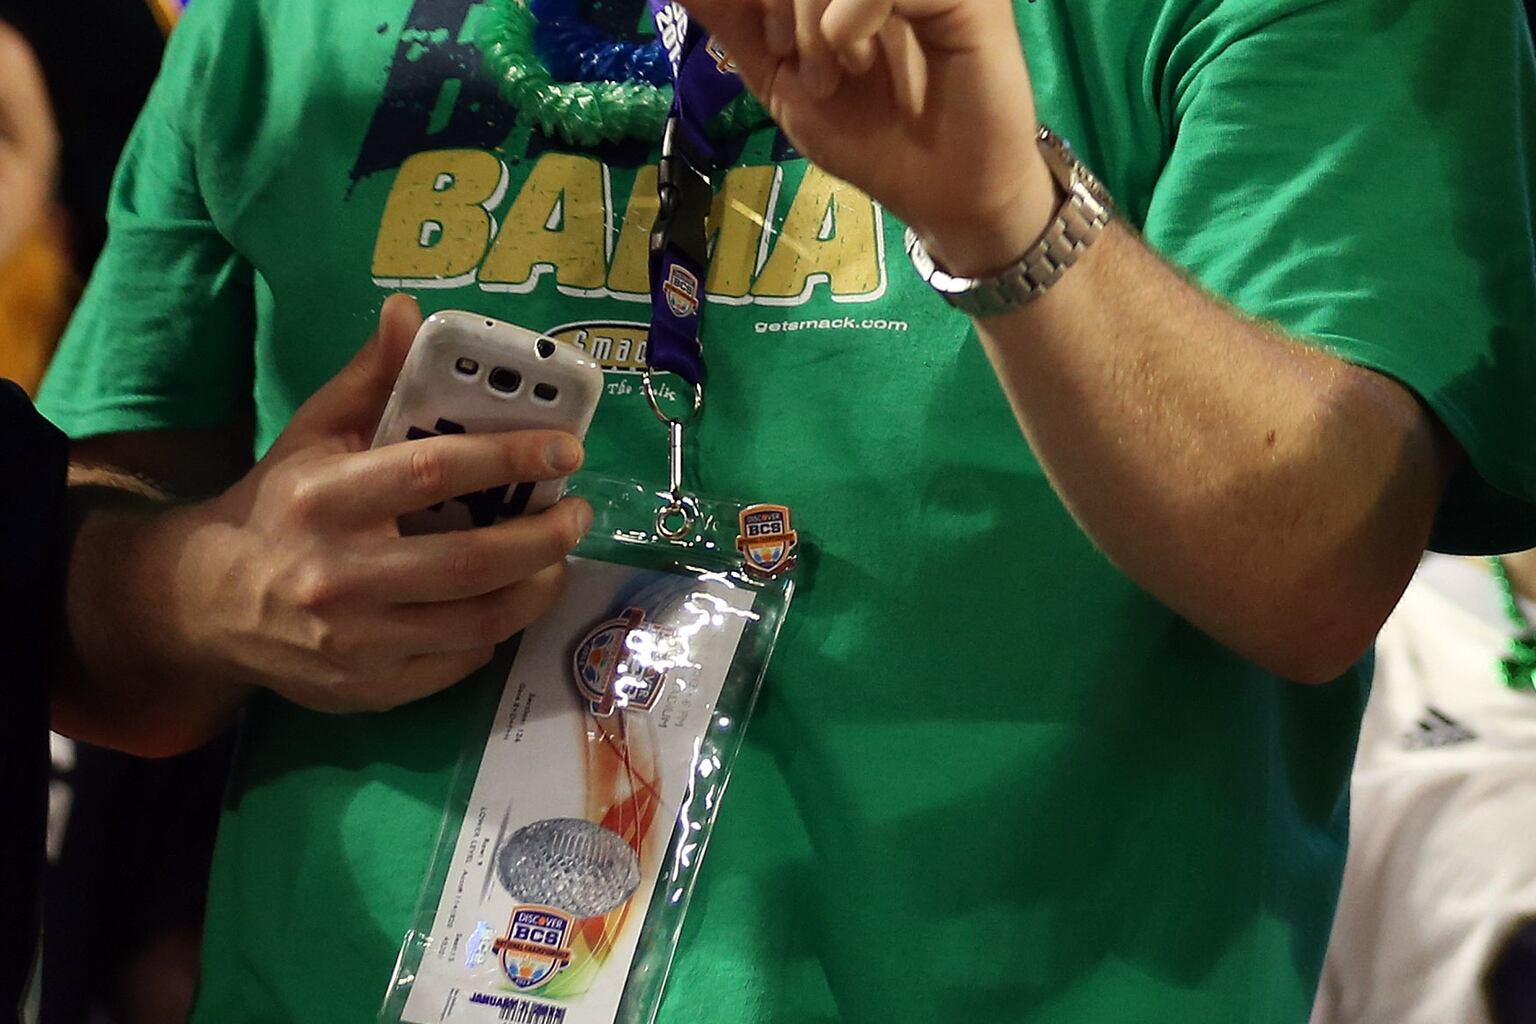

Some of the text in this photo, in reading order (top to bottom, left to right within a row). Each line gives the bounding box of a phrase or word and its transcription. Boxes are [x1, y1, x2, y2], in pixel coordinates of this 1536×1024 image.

[754, 316, 909, 334] getsmack.com
[747, 521, 783, 538] BCS
[513, 925, 561, 946] BCS
